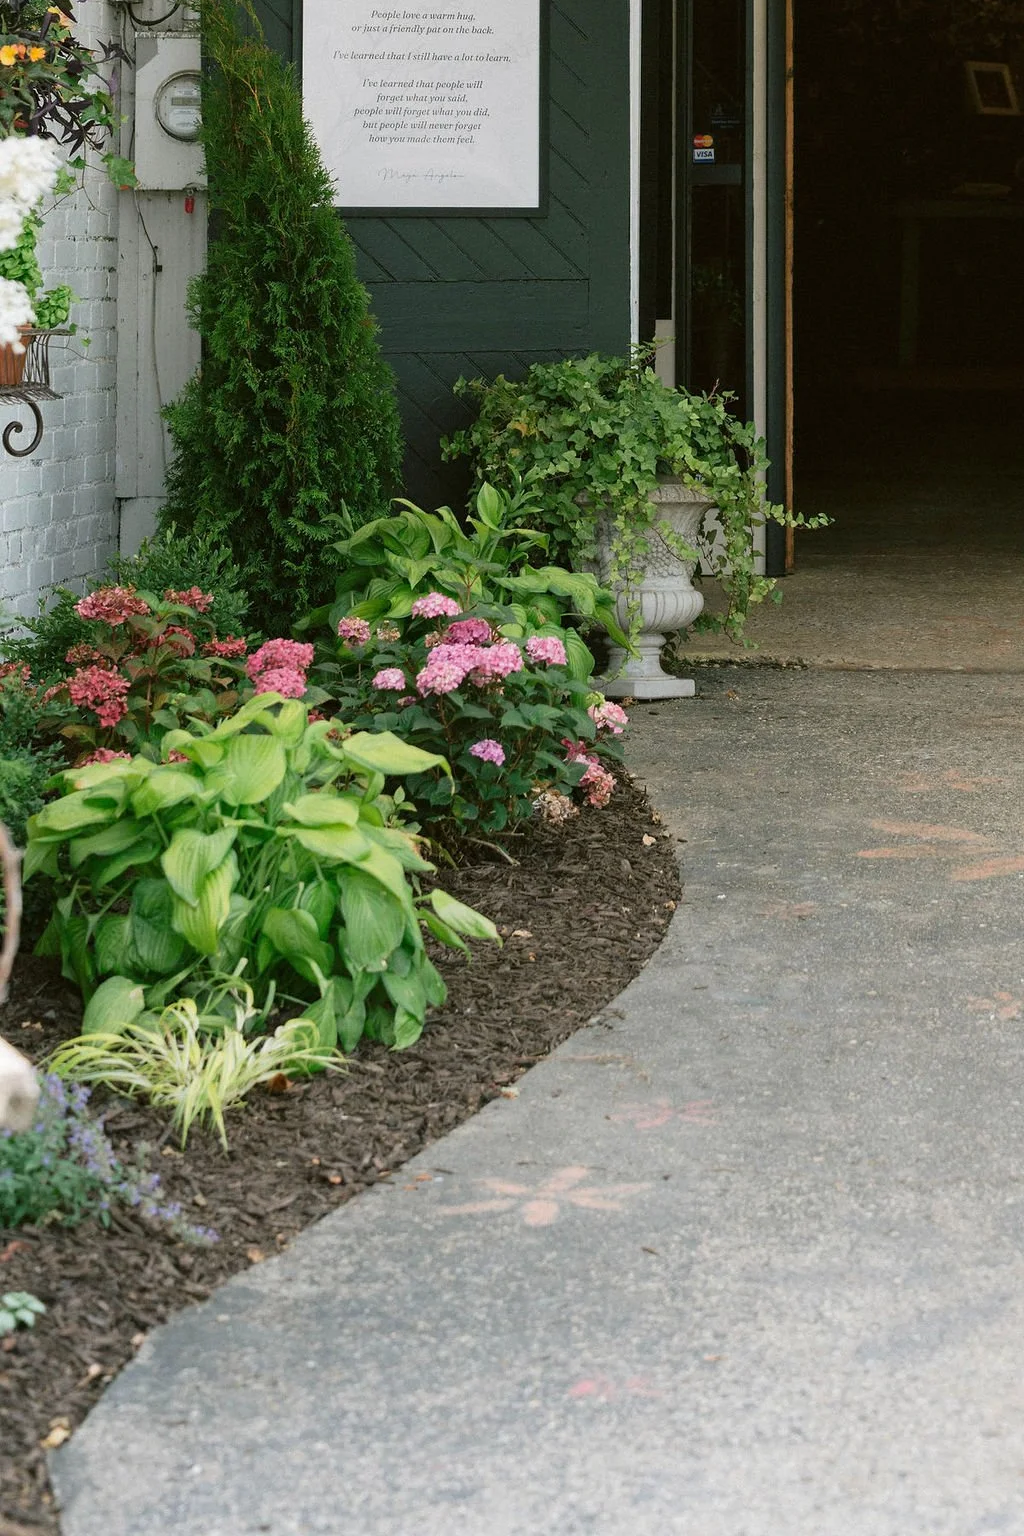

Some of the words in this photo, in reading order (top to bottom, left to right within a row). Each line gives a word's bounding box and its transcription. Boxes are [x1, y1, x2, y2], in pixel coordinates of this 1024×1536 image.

[371, 10, 401, 20] People
[402, 10, 421, 19] love
[362, 24, 381, 34] just
[388, 24, 426, 35] friendly
[426, 26, 441, 35] pat
[455, 26, 470, 34] the
[471, 26, 494, 34] back.
[333, 50, 349, 60] I've
[350, 51, 385, 60] learned
[386, 52, 406, 60] that
[407, 52, 412, 60] I
[412, 52, 431, 61] still
[431, 53, 453, 61] have
[461, 53, 473, 61] lot
[362, 78, 378, 88] I've
[379, 79, 415, 88] learned
[415, 80, 434, 88] that
[435, 80, 465, 90] people
[466, 80, 483, 89] will
[376, 93, 404, 104] forget
[406, 93, 428, 102] what
[428, 95, 446, 104] you
[353, 106, 383, 117] people
[385, 107, 402, 115] will
[403, 107, 430, 118] forget
[432, 107, 454, 116] what
[454, 109, 472, 118] you
[362, 120, 378, 129] but
[379, 121, 409, 131] people
[410, 121, 427, 129] will
[454, 121, 482, 132] forget
[368, 134, 388, 143] how
[387, 136, 406, 145] you
[407, 135, 432, 143] made
[432, 135, 456, 144] them
[456, 135, 475, 144] feel.
